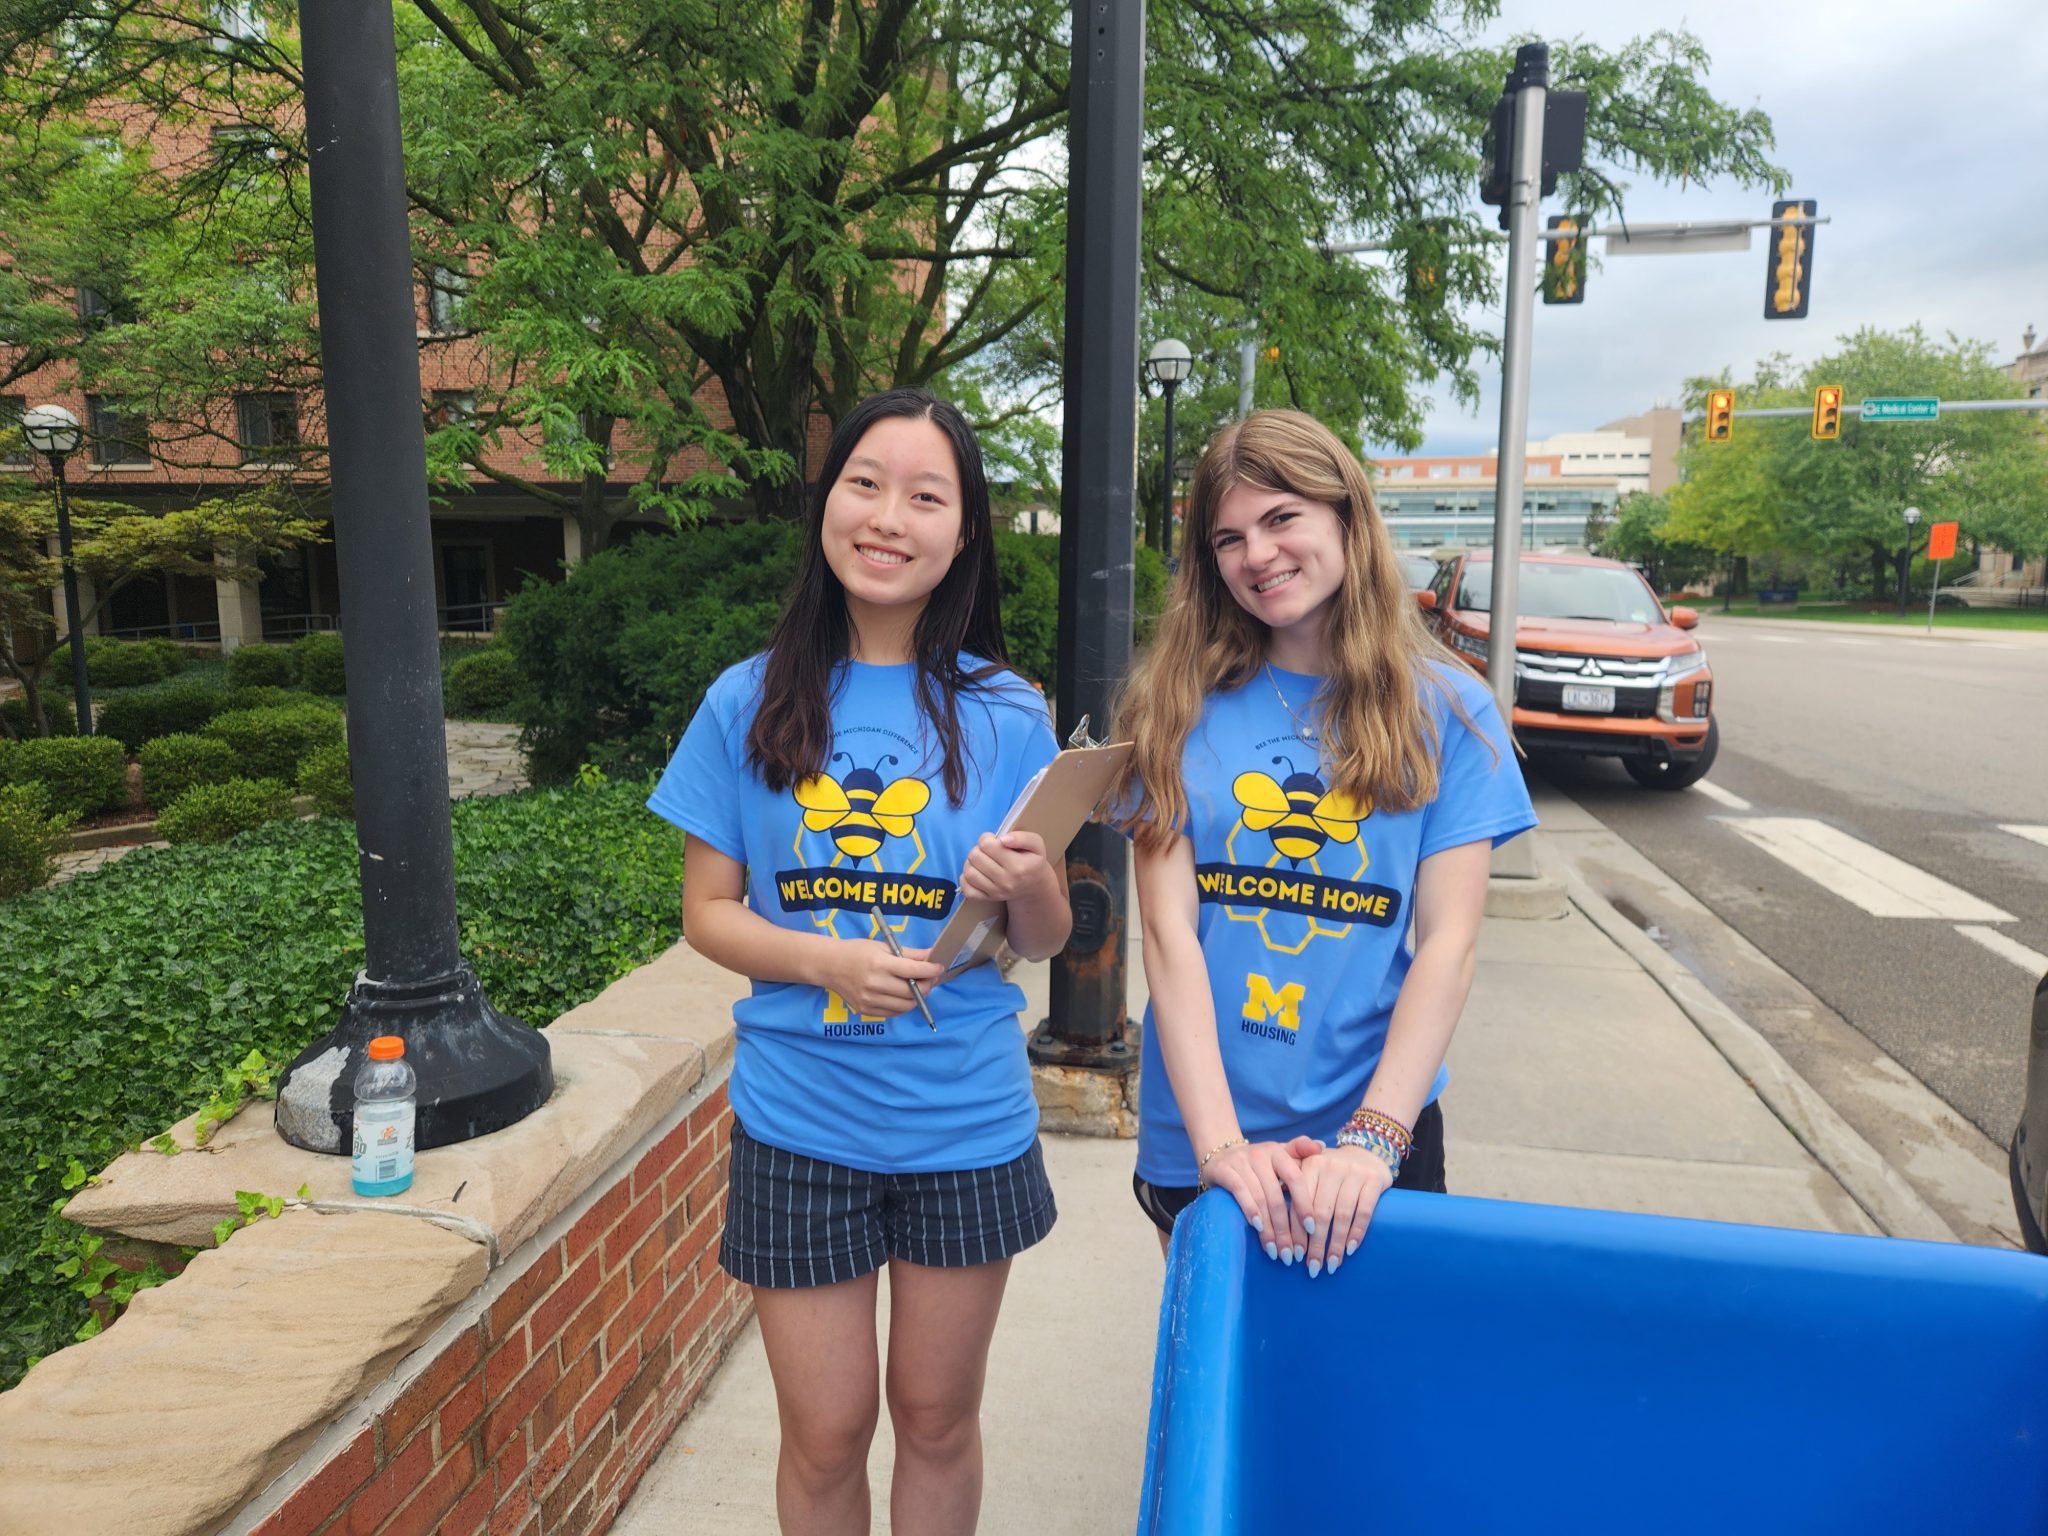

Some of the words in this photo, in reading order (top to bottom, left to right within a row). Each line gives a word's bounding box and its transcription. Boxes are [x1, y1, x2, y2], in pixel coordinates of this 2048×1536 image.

[843, 726, 881, 735] MICHIGAN
[882, 729, 919, 755] DIFFERENCE
[1268, 736, 1280, 745] THE
[780, 877, 878, 904] WELCOME
[882, 882, 946, 910] HOME
[1198, 872, 1315, 906] WELCOME
[1322, 887, 1390, 917] HOME
[1241, 972, 1306, 1031] M
[824, 1023, 885, 1038] HOUSING
[1241, 1019, 1297, 1046] HOUSING
